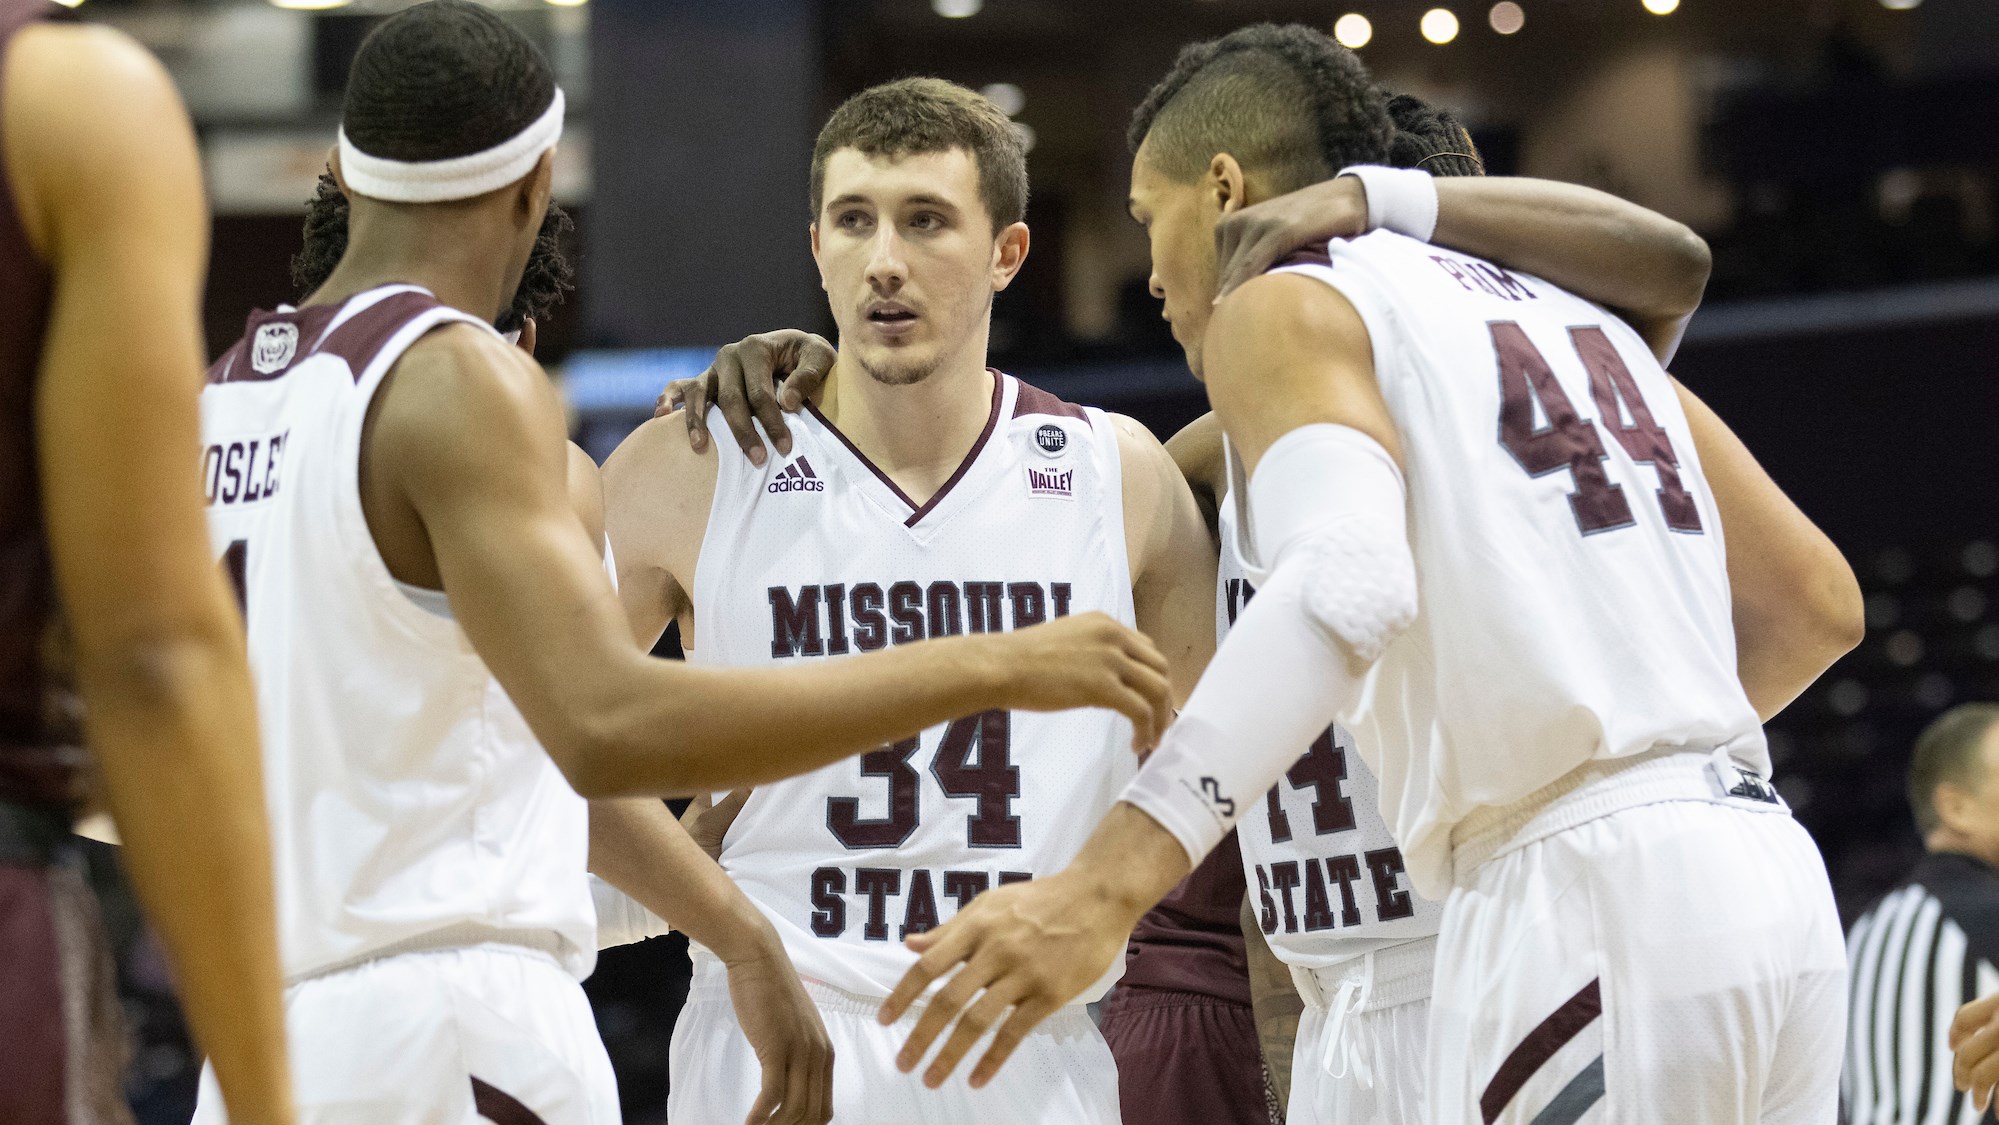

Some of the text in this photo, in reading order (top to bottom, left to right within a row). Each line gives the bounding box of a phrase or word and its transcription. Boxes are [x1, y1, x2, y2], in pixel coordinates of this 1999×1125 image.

[1039, 437, 1065, 447] UNITE
[1485, 319, 1705, 537] 44
[768, 477, 824, 493] adidas
[1028, 468, 1073, 491] VALLEY
[826, 708, 1022, 850] 34
[810, 866, 1033, 943] STAT
[1255, 846, 1414, 935] STATE
